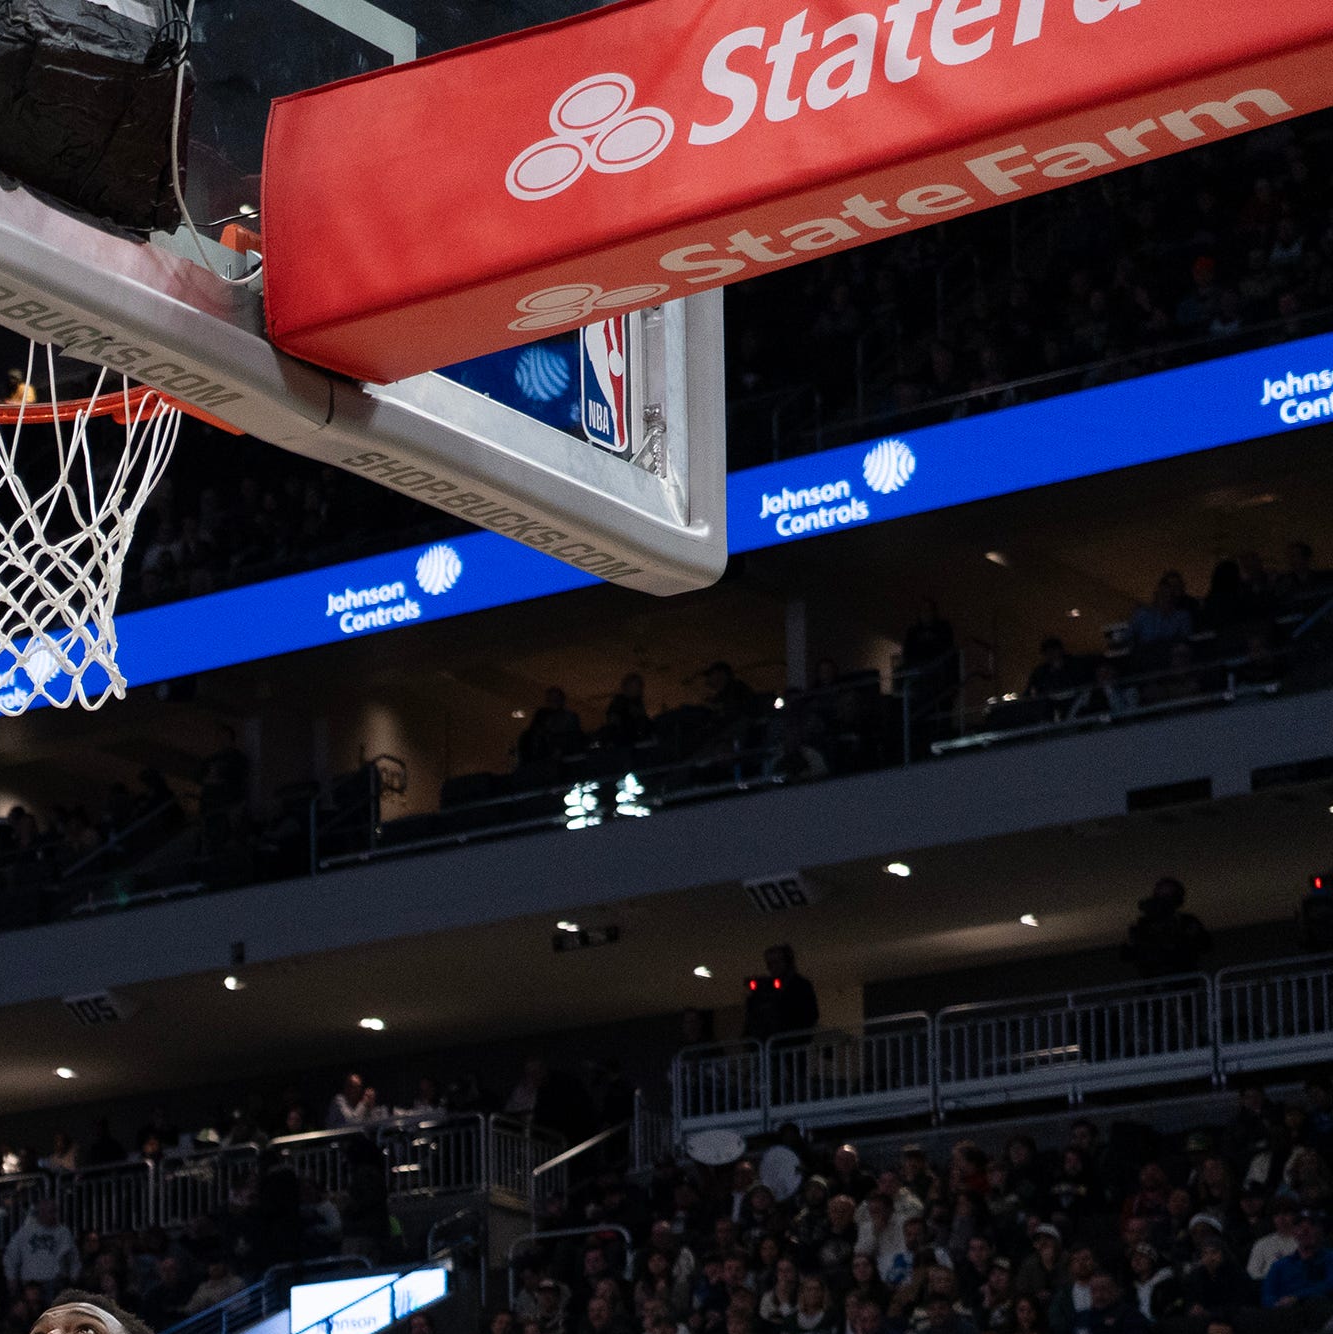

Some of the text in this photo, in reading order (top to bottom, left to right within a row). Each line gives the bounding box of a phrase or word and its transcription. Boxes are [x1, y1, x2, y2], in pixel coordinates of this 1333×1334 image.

[659, 88, 1295, 285] StateFarm
[588, 399, 609, 435] NBA
[341, 452, 645, 580] SHOP.BUCKS.COM
[760, 478, 850, 520] Johnson
[775, 496, 869, 537] Controls
[327, 581, 405, 615] Johnson
[339, 599, 420, 634] Controls
